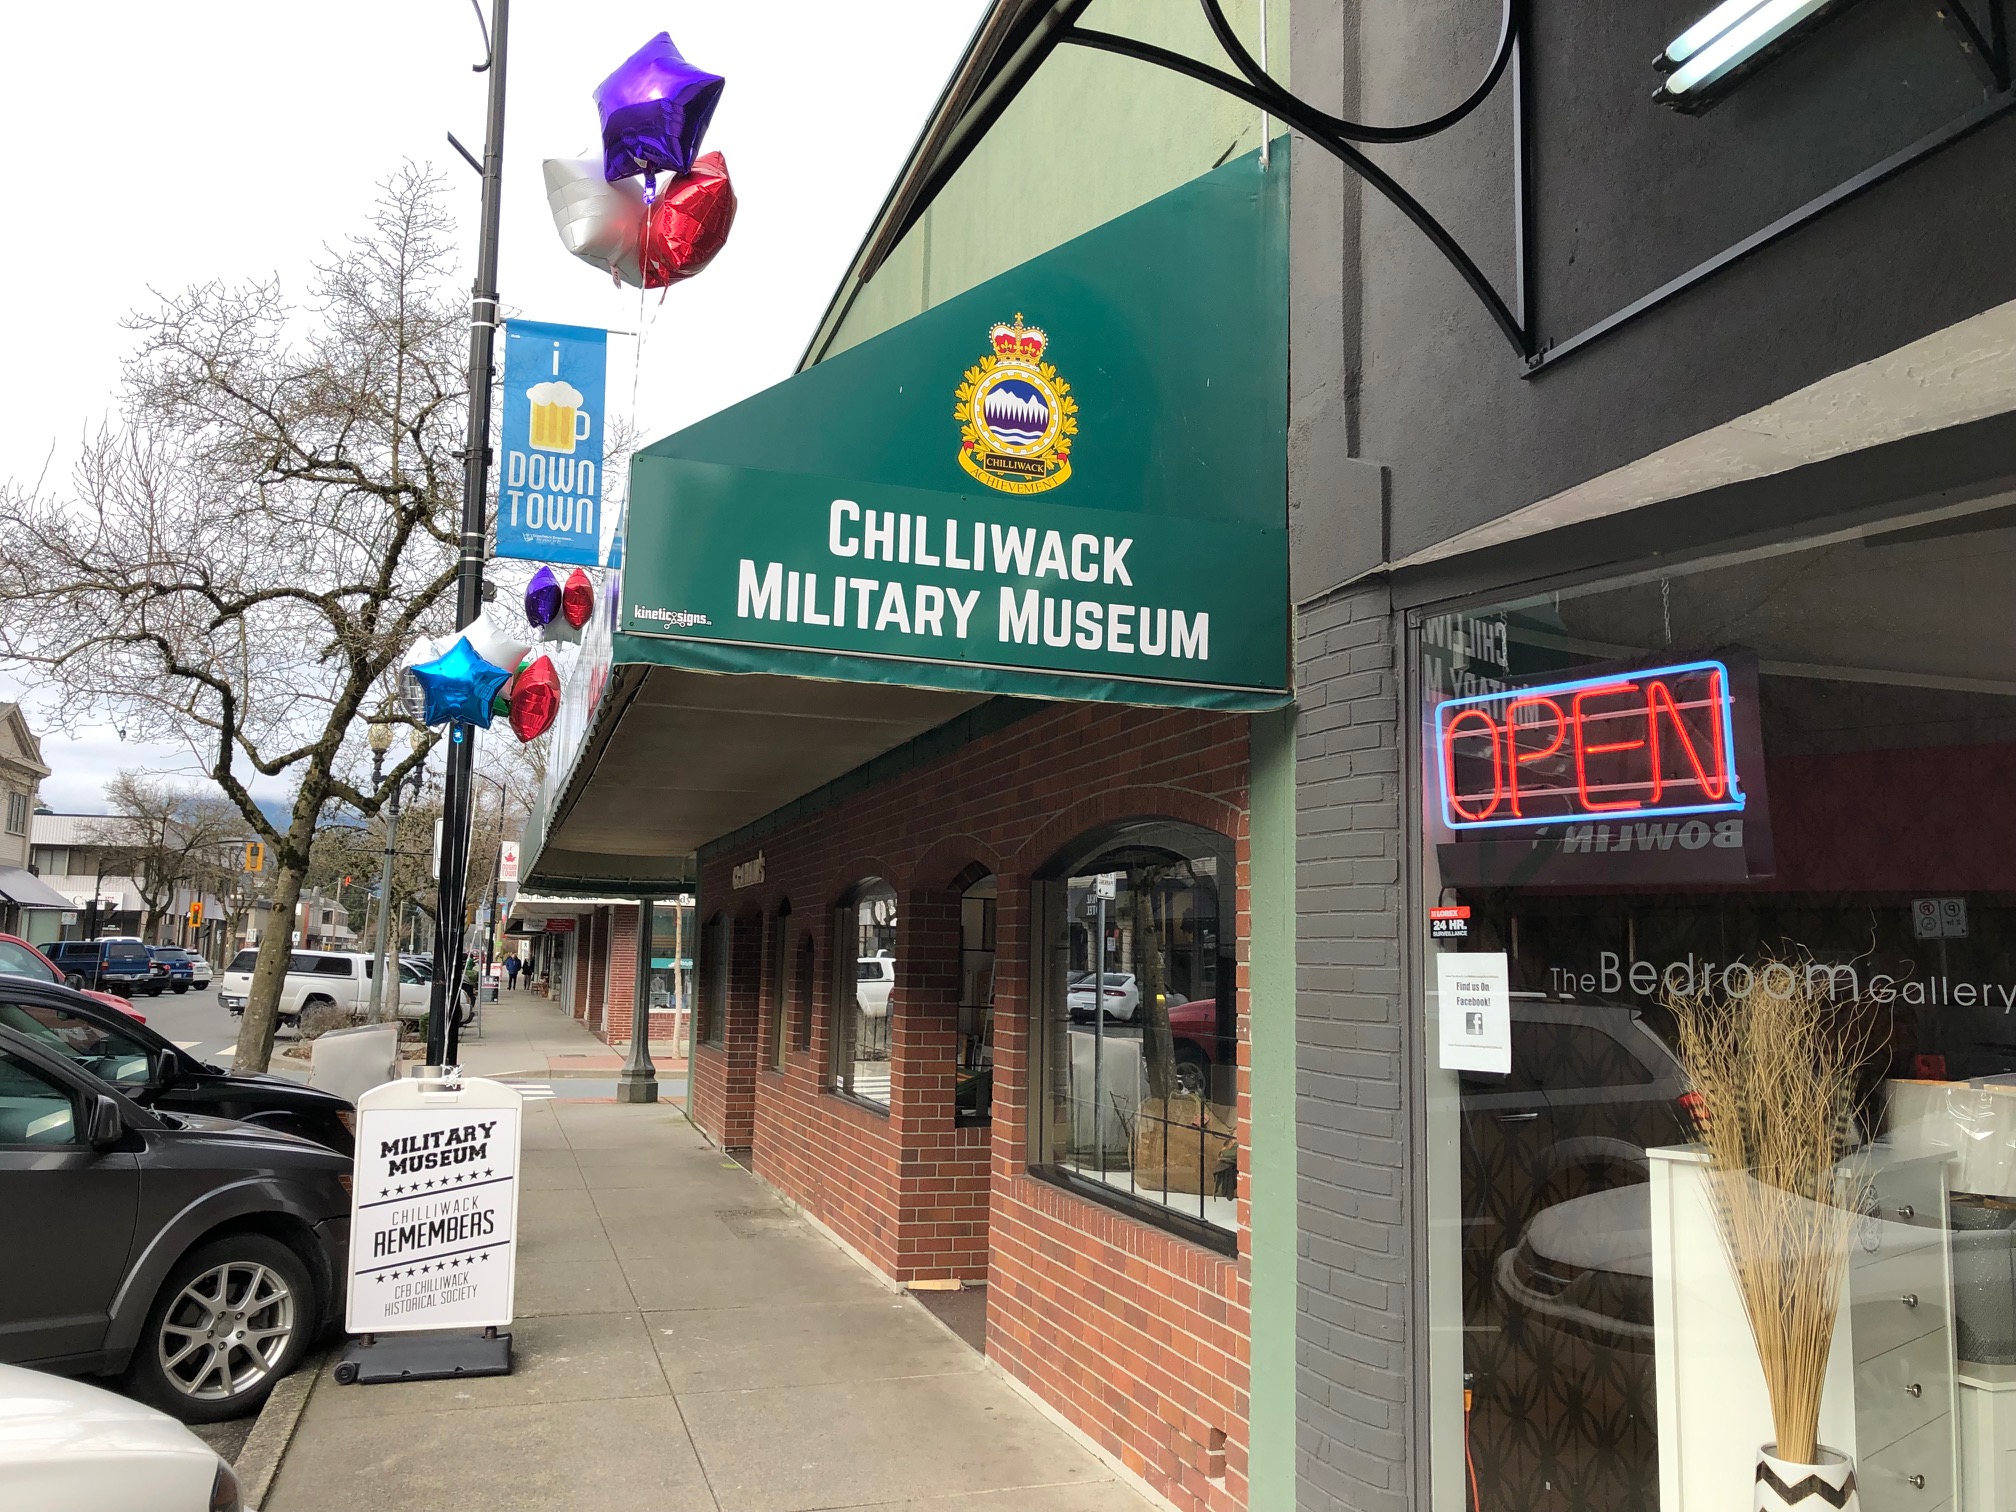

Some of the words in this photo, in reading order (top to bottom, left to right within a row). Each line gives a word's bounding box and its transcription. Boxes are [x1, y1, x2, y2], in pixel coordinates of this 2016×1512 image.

[507, 450, 595, 496] DOWN
[970, 468, 1059, 494] ACHIEVEMENT
[986, 457, 1044, 473] CHILLIWACK
[507, 490, 594, 534] TOWN
[828, 499, 1133, 587] CHILLIWACK
[737, 559, 980, 639] MILITARY
[998, 587, 1209, 660] MUSEUM
[1443, 670, 1726, 821] OPEN
[1433, 920, 1447, 931] 24
[1449, 919, 1467, 931] HR.
[1456, 982, 1470, 992] Find
[1471, 983, 1480, 992] us
[1481, 982, 1490, 992] On
[1550, 967, 1596, 993] The
[1600, 951, 1859, 1001] Bedroom
[1869, 974, 2016, 1015] Gallery
[1456, 996, 1491, 1007] Facebook!
[379, 1120, 498, 1158] MILITARY
[388, 1142, 488, 1177] MUSEUM
[392, 1195, 479, 1226] CHILLIWACK
[373, 1209, 495, 1258] REMEMBERS
[384, 1294, 437, 1317] HISTORICAL
[440, 1284, 478, 1305] SOCIETY
[394, 1283, 412, 1300] CFB
[414, 1271, 470, 1296] CHILLIWACK
